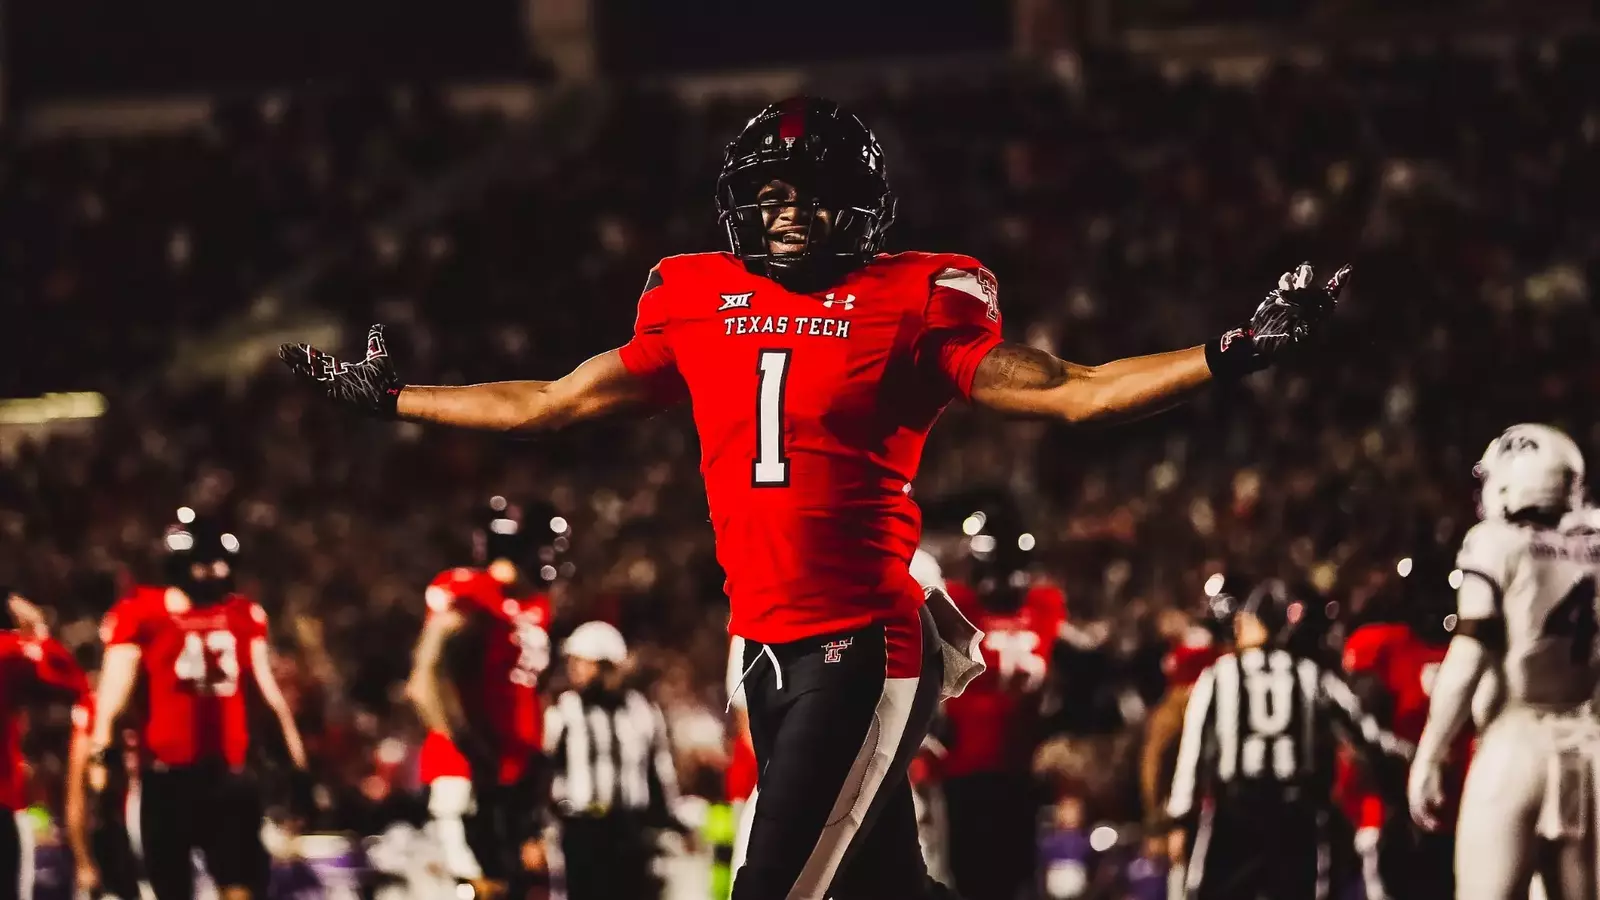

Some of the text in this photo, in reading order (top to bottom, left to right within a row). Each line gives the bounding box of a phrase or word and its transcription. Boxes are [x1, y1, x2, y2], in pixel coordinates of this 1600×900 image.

[717, 292, 754, 312] XII
[723, 316, 850, 339] TEXAS TECH
[753, 348, 792, 488] 1
